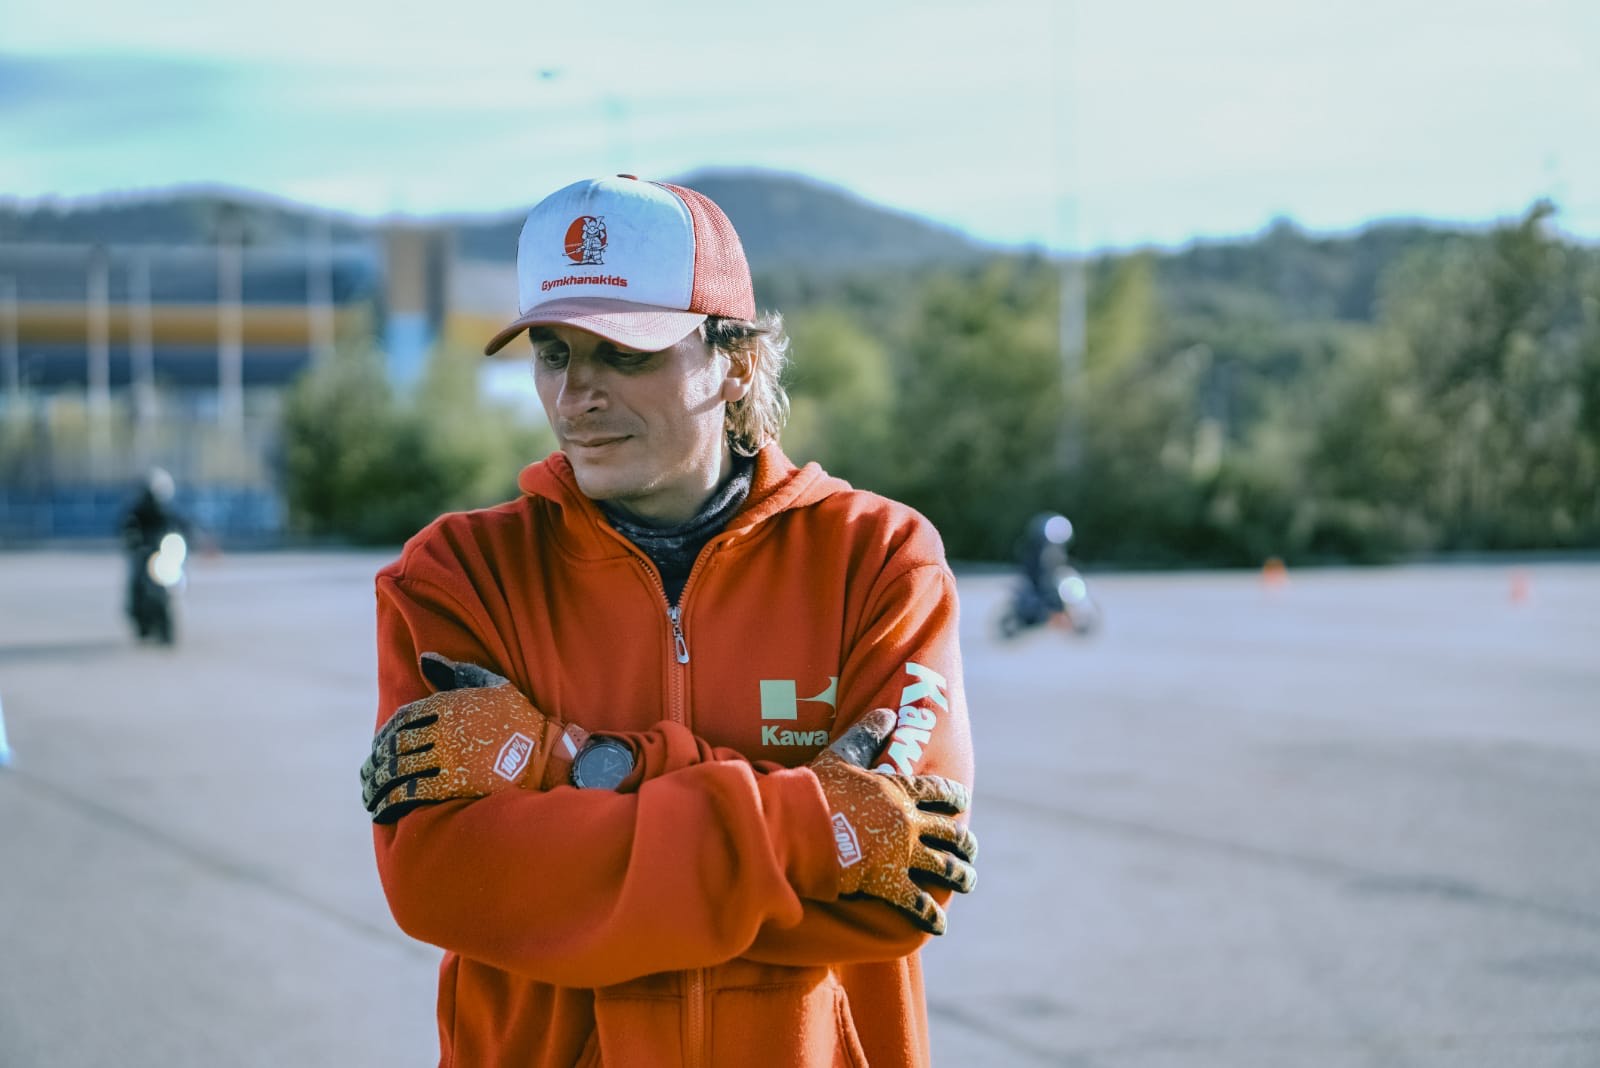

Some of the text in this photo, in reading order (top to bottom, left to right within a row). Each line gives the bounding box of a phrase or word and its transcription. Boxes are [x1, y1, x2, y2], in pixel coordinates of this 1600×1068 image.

[541, 275, 628, 291] Gymkhanakids
[501, 739, 528, 774] 100%
[833, 820, 857, 858] 100%
